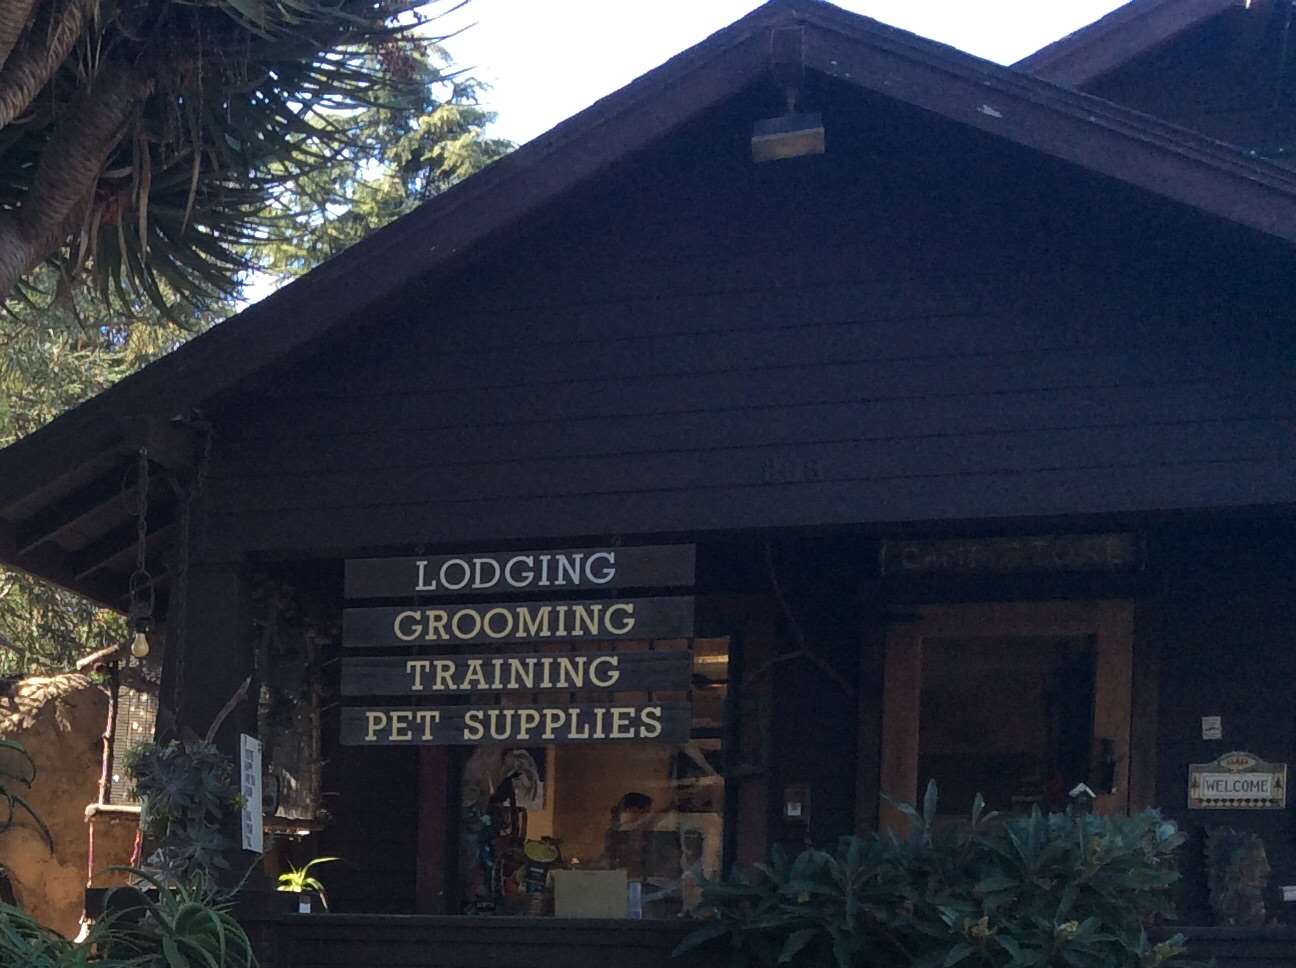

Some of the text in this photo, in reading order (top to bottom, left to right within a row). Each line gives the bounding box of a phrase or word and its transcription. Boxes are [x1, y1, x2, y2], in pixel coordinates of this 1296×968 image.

[415, 552, 616, 591] LODGING
[394, 603, 636, 641] GROOMING
[406, 656, 621, 691] TRAINING
[365, 706, 662, 741] PET SUPPLIES
[1206, 779, 1269, 793] WELCOME
